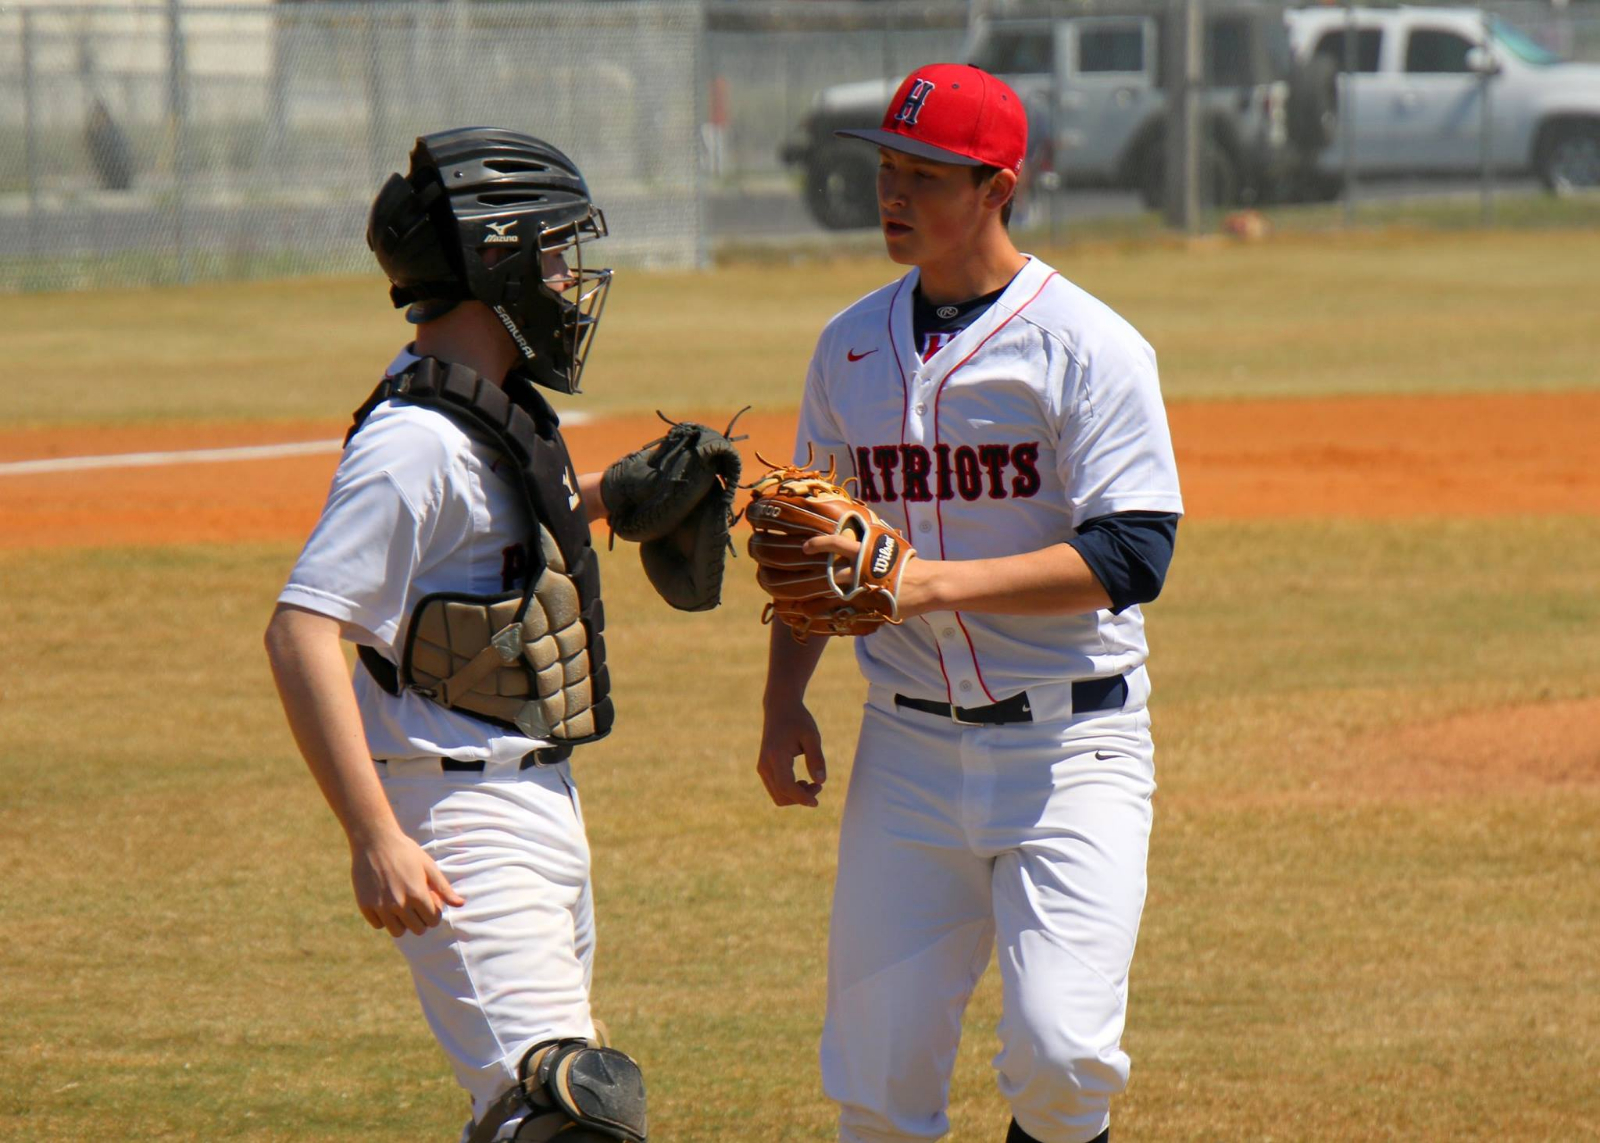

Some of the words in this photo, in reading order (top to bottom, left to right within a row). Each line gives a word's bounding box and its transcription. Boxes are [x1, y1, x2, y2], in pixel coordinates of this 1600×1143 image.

[894, 78, 935, 125] H
[493, 304, 536, 360] SAMURAI
[847, 441, 1042, 502] ATRIOTS
[872, 534, 896, 574] Wilson
